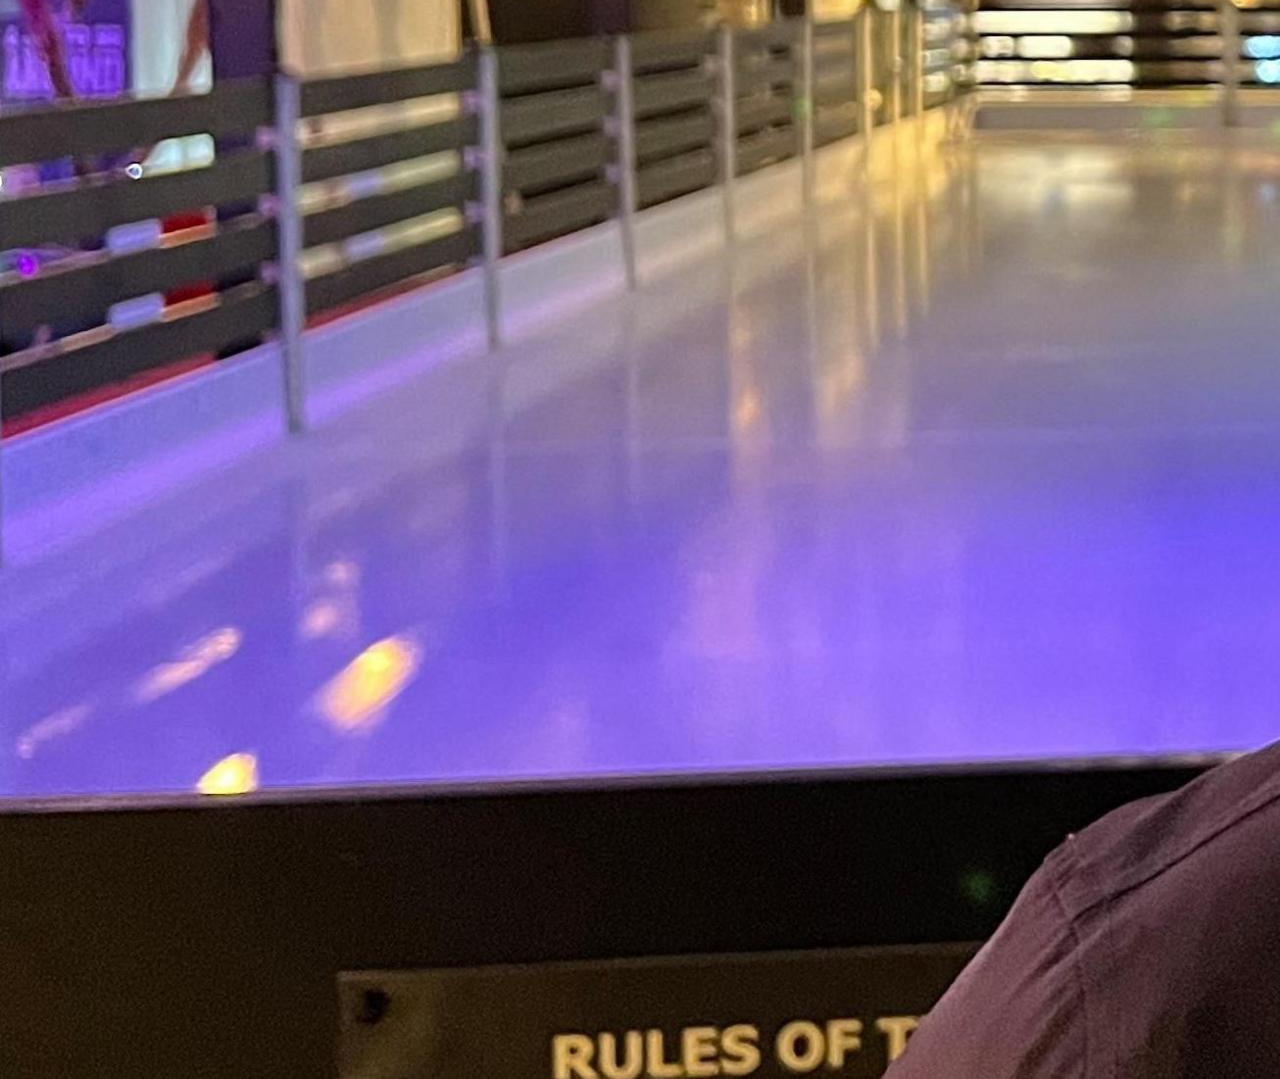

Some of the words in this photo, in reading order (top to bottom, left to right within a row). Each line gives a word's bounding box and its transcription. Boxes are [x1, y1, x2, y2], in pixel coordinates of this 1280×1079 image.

[552, 1023, 761, 1079] RULES
[776, 1019, 863, 1072] OF
[876, 1015, 921, 1062] T
